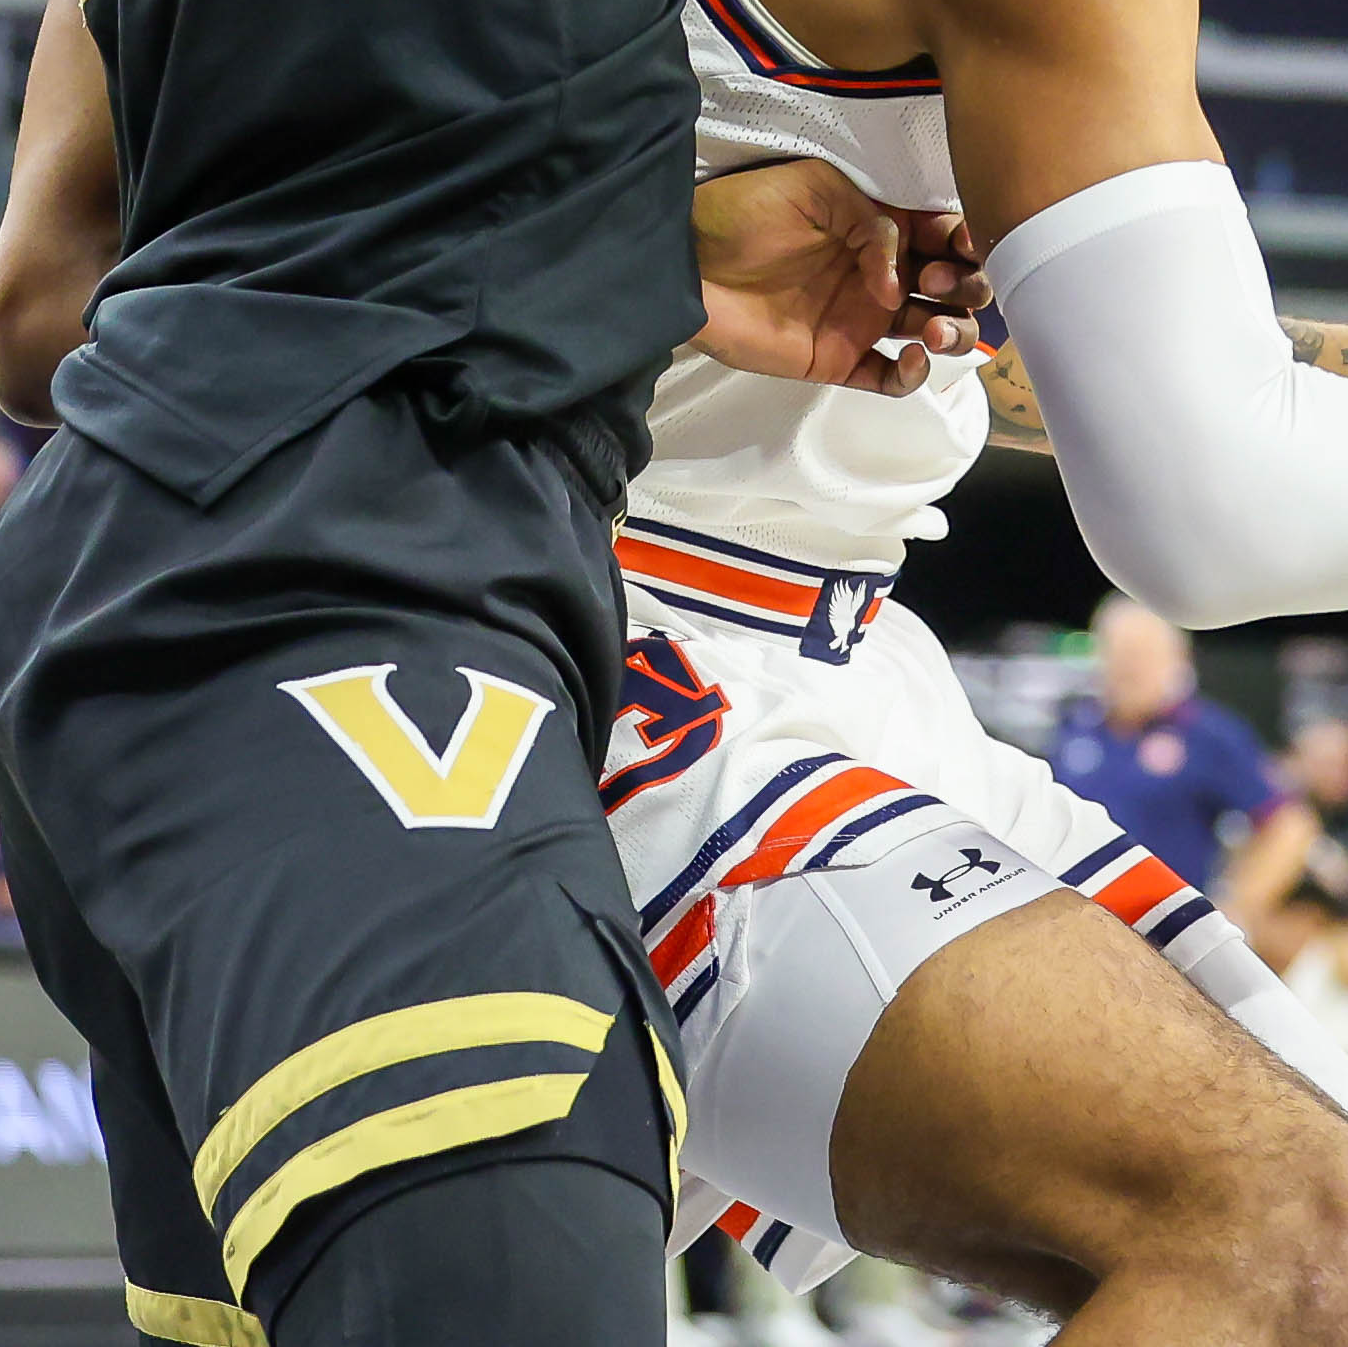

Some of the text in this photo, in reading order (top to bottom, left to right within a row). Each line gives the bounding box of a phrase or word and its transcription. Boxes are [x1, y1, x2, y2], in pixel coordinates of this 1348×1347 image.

[277, 663, 556, 830] V
[933, 867, 1027, 921] UNDER ARMOUR
